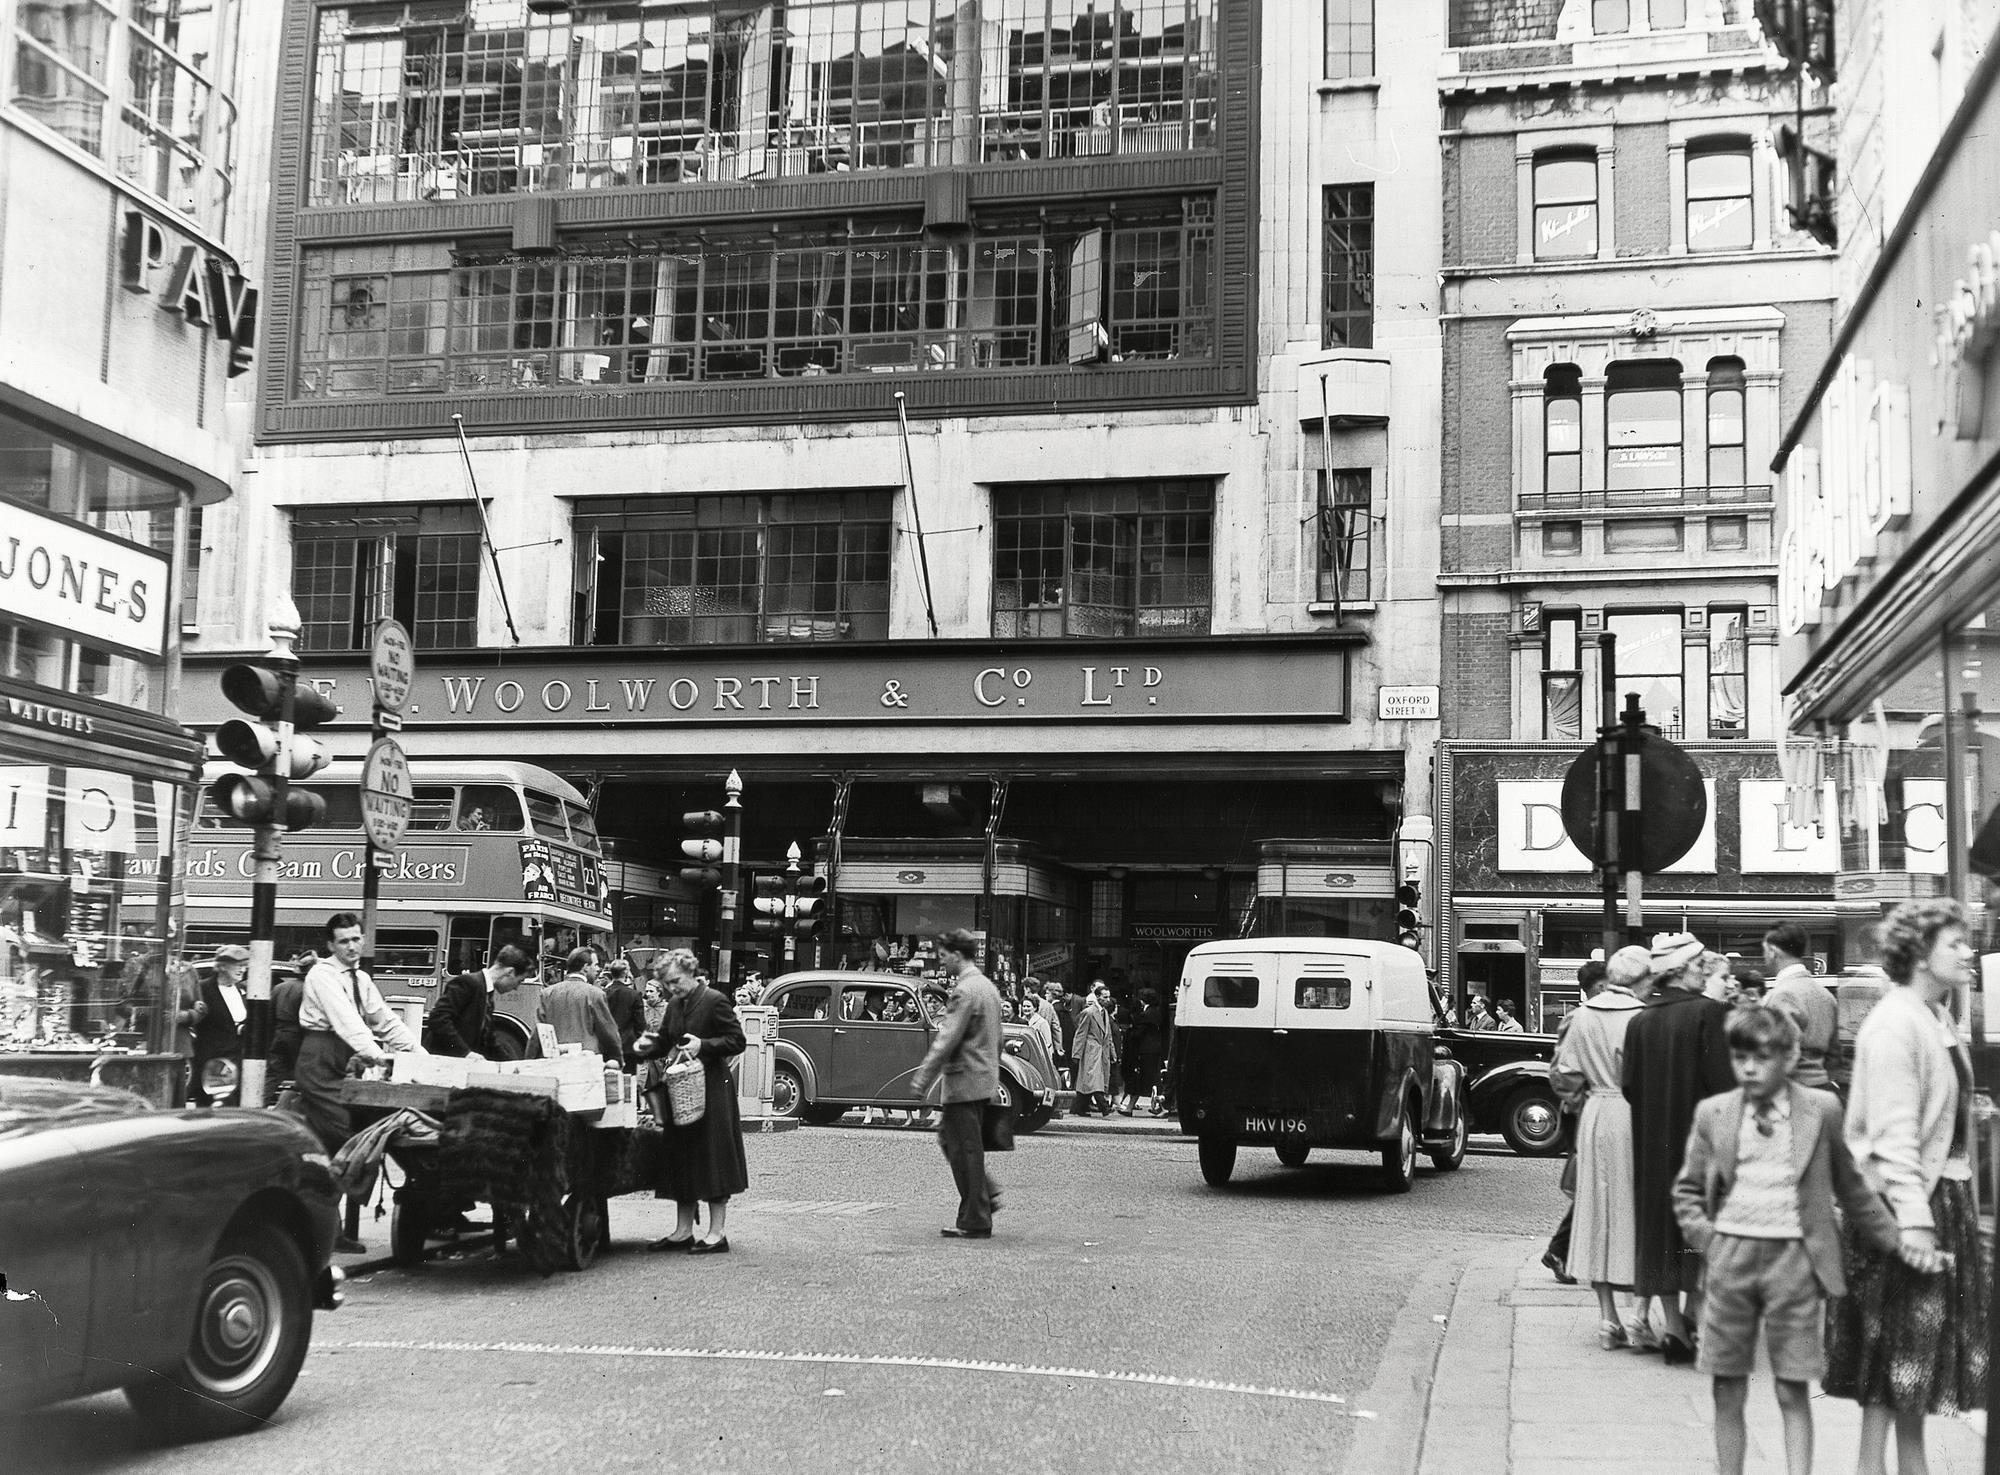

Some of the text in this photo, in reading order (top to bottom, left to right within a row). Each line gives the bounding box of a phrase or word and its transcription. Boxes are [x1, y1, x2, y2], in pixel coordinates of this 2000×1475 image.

[0, 536, 149, 623] JONES
[441, 675, 820, 713] WOOLWORTH
[880, 679, 908, 708] &
[1388, 695, 1430, 705] OXFORD
[8, 697, 94, 734] WATCHES
[1385, 706, 1415, 716] STREET
[381, 769, 398, 794] NO
[238, 849, 323, 879] Ceam
[331, 850, 457, 880] Crckers
[1135, 926, 1213, 938] WOOLWORTHS
